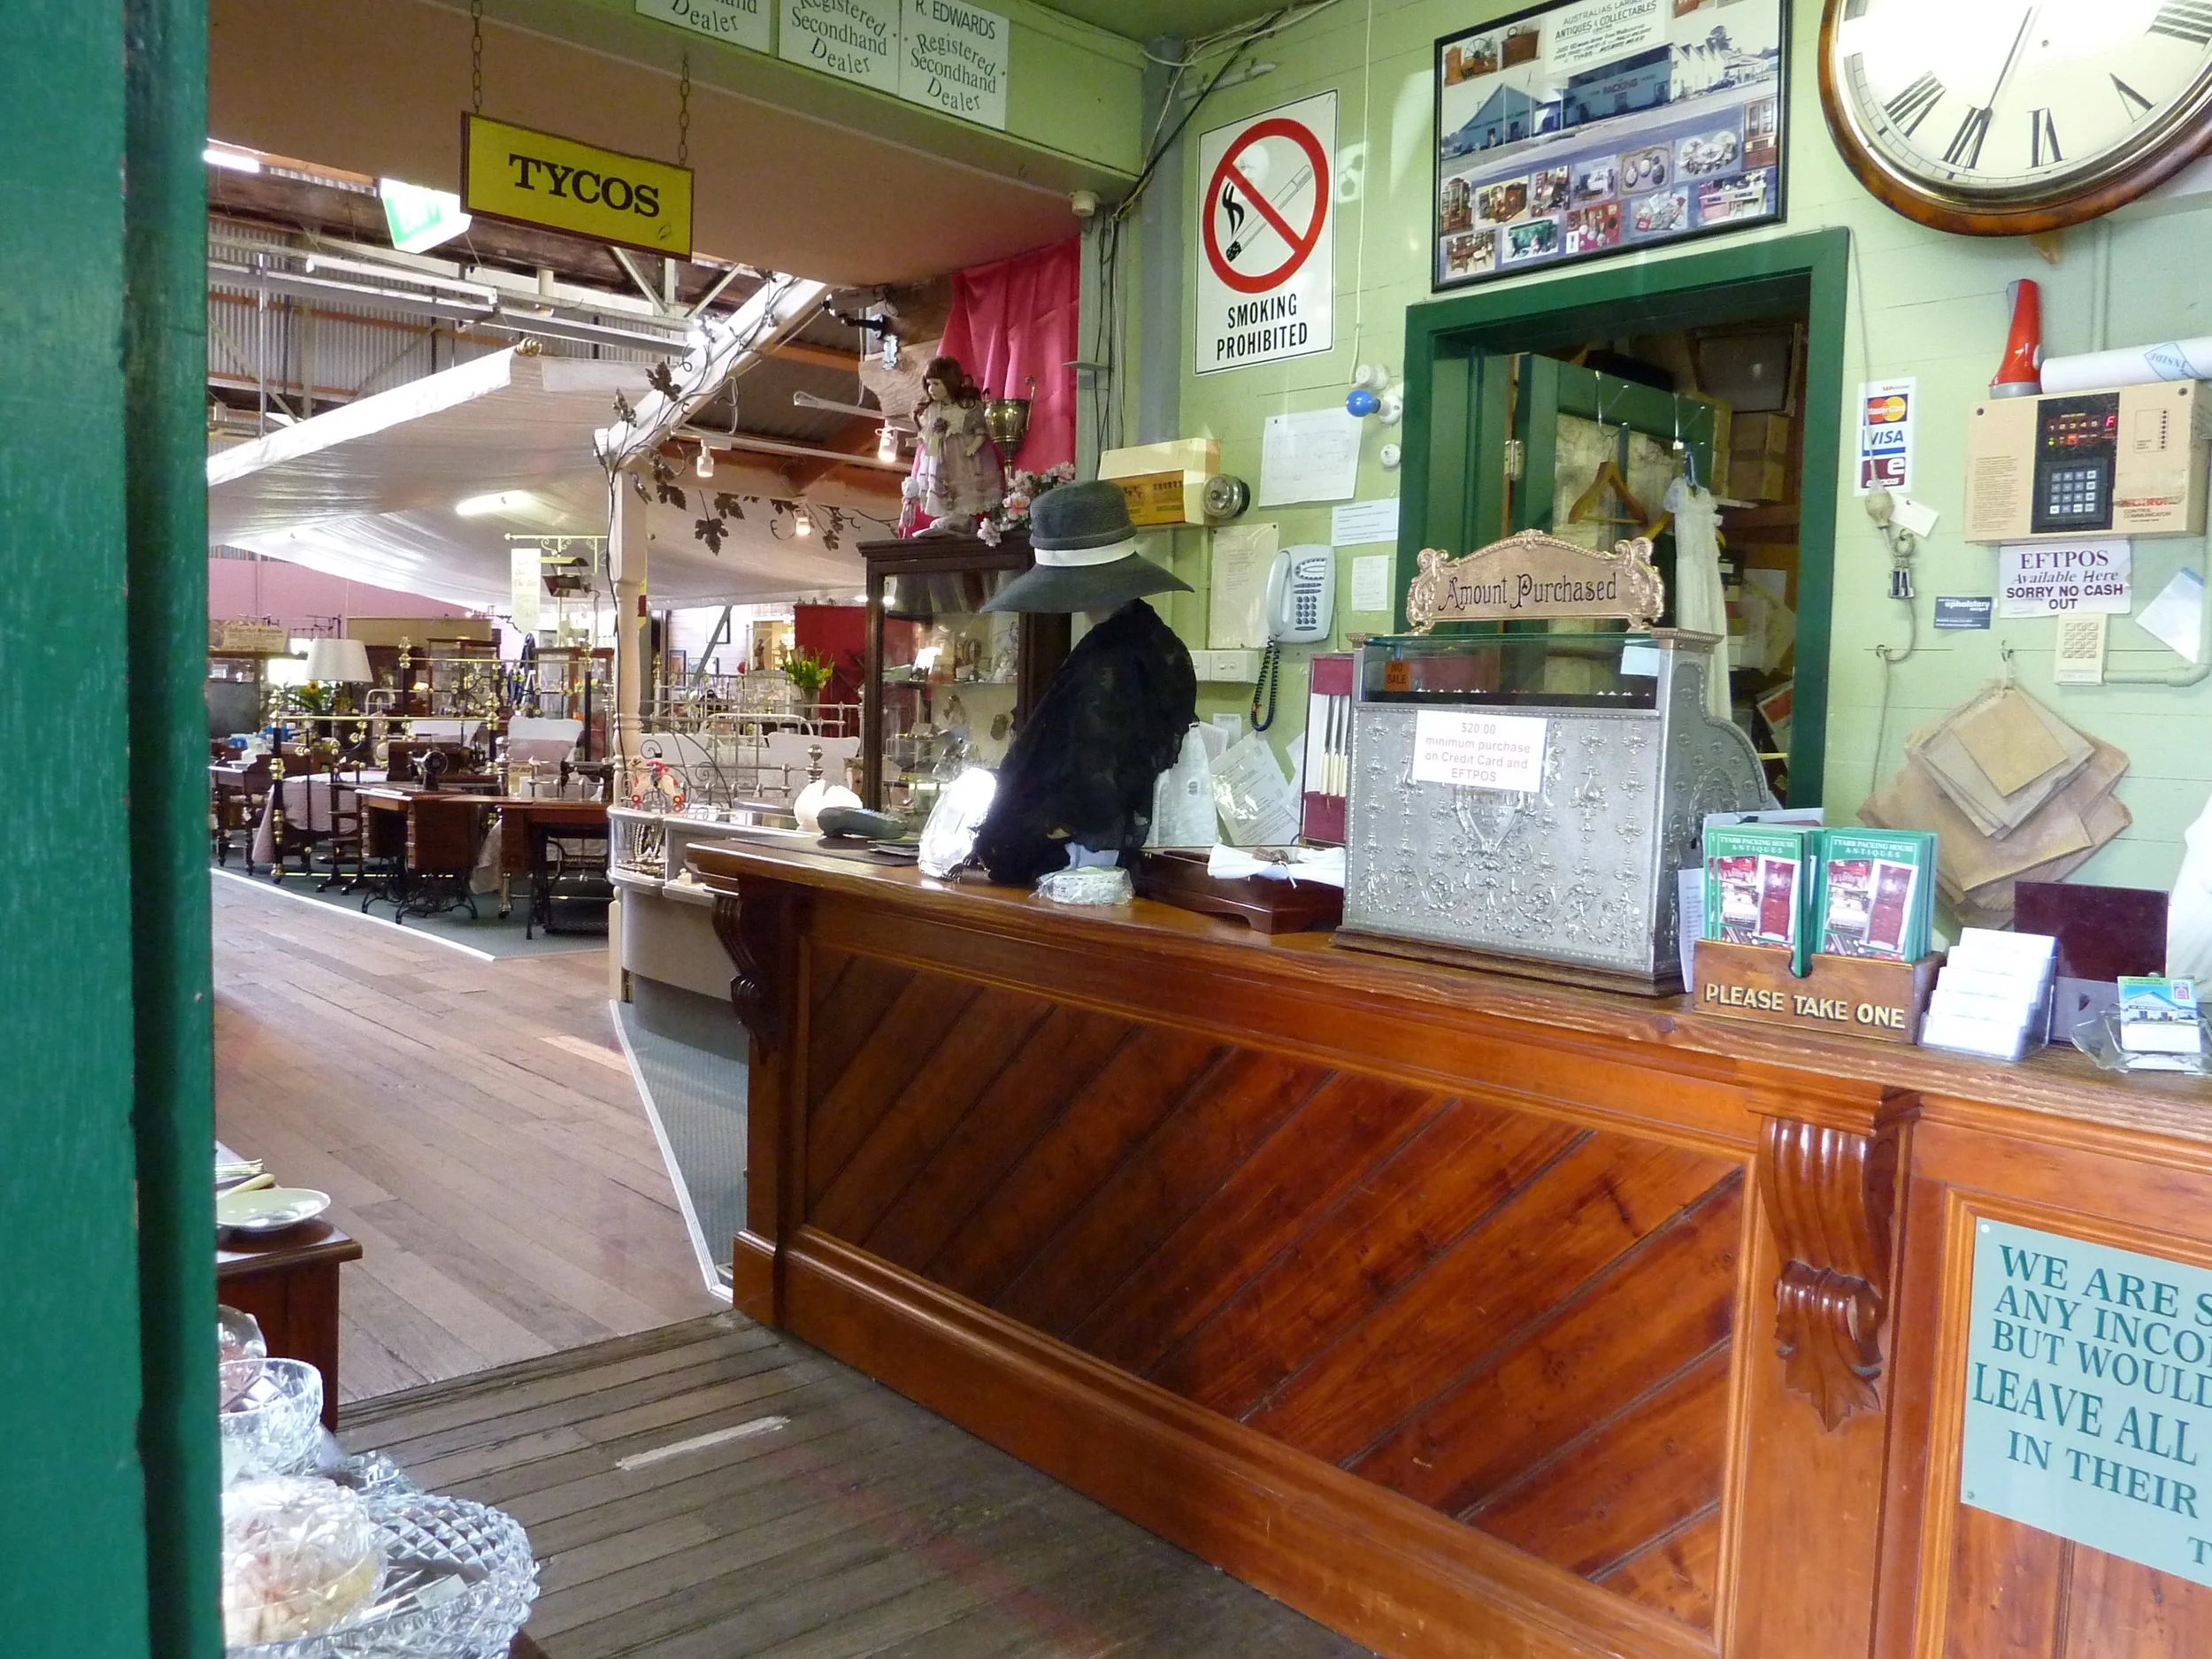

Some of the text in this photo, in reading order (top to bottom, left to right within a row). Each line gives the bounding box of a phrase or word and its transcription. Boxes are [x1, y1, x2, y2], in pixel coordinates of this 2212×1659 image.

[671, 0, 739, 33] Dealer
[791, 6, 887, 57] Secondhand
[933, 1, 995, 41] EDWARDS
[1555, 20, 1592, 40] ANTIQUES
[1600, 1, 1657, 27] COLLECTABLES
[810, 36, 871, 73] Dealer
[910, 47, 996, 95] Secondhand
[917, 33, 996, 77] Registered
[926, 76, 980, 111] Dealer
[509, 153, 660, 219] TYCOS
[1227, 292, 1297, 329] SMOKING
[1217, 321, 1308, 361] PROHIBITED
[1870, 429, 1904, 445] VISA
[2105, 415, 2116, 427] F
[2021, 549, 2109, 570] EFTPOS
[1438, 572, 1617, 611] Amount Purchased
[2006, 584, 2124, 599] SORRY NO CASH
[2011, 570, 2118, 585] Available Here
[2048, 598, 2078, 610] OUT
[1387, 674, 1406, 684] SALE
[1391, 663, 1402, 672] NO
[1425, 737, 1531, 754] minimum purchase
[1462, 722, 1496, 735] $20.00
[1425, 751, 1528, 770] on Credit Card and
[1451, 767, 1497, 782] EFTPOS
[1732, 845, 1784, 855] ANTIQUES
[1742, 838, 1771, 847] PACKING
[1845, 847, 1901, 858] ANTIQUES
[1857, 841, 1887, 849] PACKING
[1704, 983, 1906, 1029] PLEASE TAKE ONE
[1999, 1243, 2070, 1292] WE
[2082, 1267, 2179, 1319] ARE
[1993, 1284, 2212, 1369] ANY INCO
[1992, 1318, 2212, 1409] BUT WOULD
[1972, 1362, 2198, 1467] LEAVE ALL
[2007, 1429, 2200, 1519] IN THEIR
